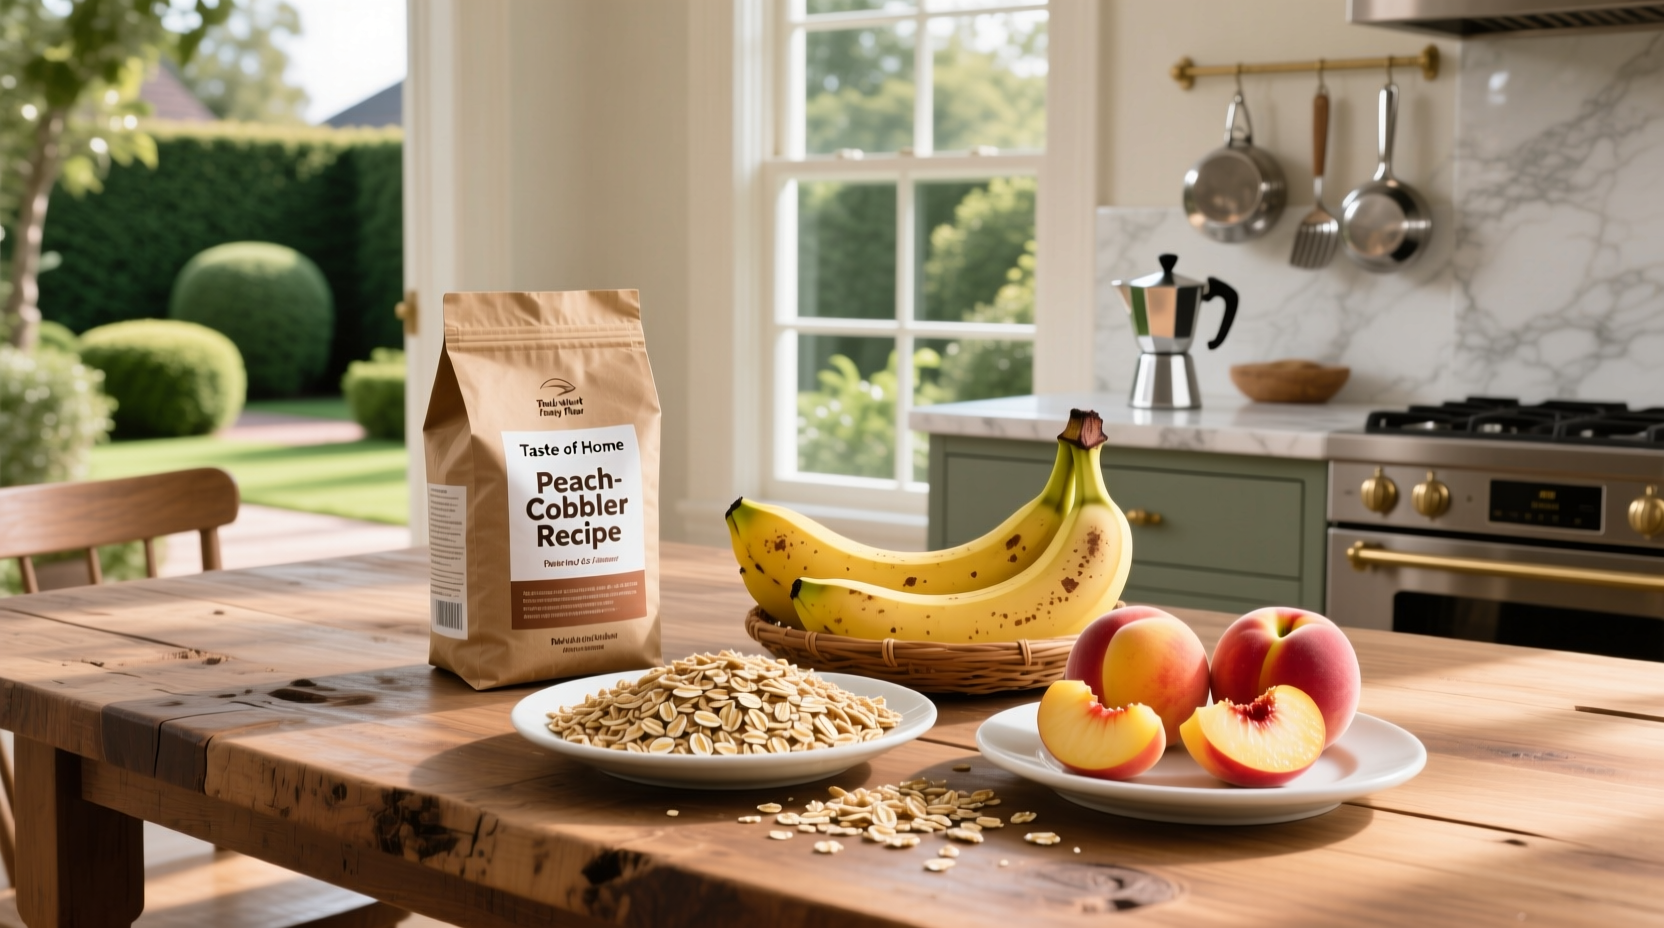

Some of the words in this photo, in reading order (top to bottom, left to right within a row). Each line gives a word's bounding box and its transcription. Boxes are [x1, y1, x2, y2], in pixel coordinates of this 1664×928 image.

[519, 443, 559, 457] Taste
[563, 441, 577, 455] of
[581, 440, 624, 454] Home
[537, 467, 622, 494] Peach-
[526, 493, 628, 521] Cobbler
[537, 521, 621, 550] Recipe
